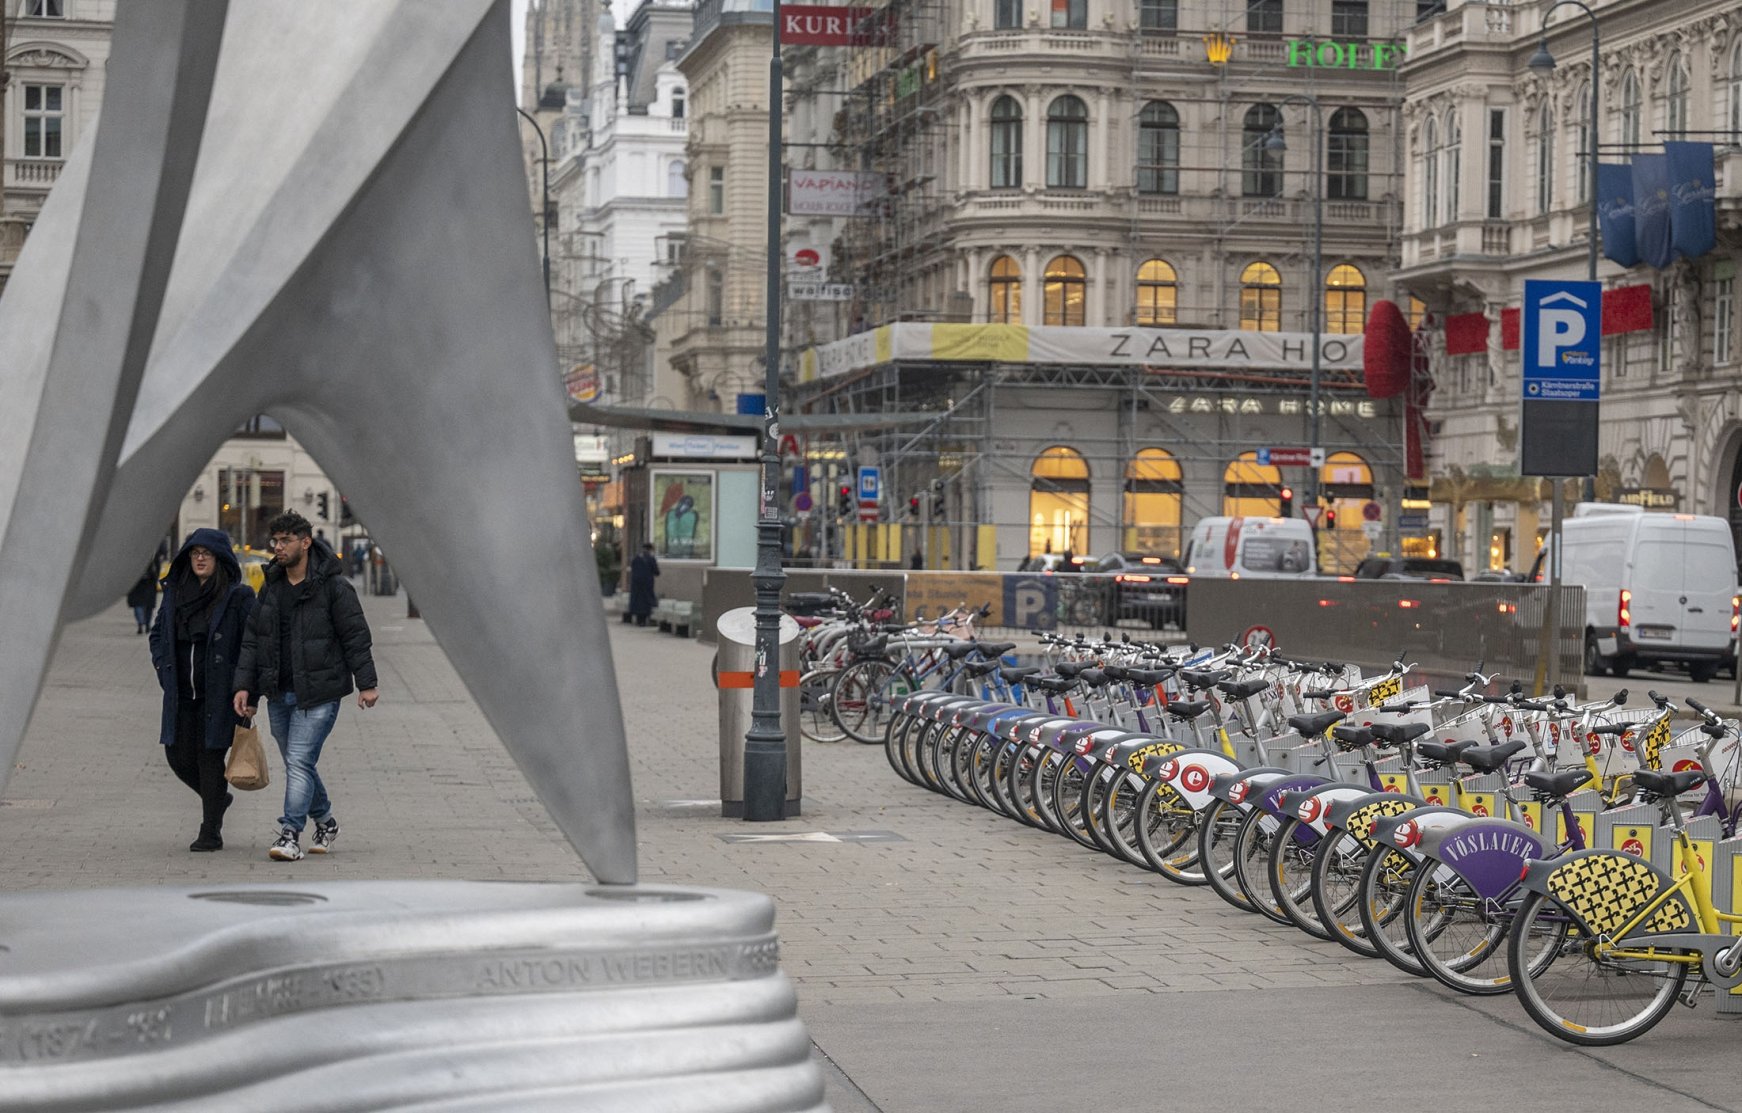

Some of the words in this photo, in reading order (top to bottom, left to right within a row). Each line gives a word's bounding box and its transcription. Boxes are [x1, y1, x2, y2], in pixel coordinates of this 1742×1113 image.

[1287, 39, 1410, 69] ROLE
[1110, 334, 1250, 359] ZARA
[1282, 340, 1348, 362] HO
[1538, 309, 1586, 367] P
[1169, 396, 1263, 414] ZARA
[1279, 399, 1376, 418] HOME
[1620, 490, 1674, 507] AIRFIELD
[1446, 832, 1534, 861] VÖSLAUER
[476, 959, 591, 989] ANTON
[599, 950, 729, 981] WEBERN
